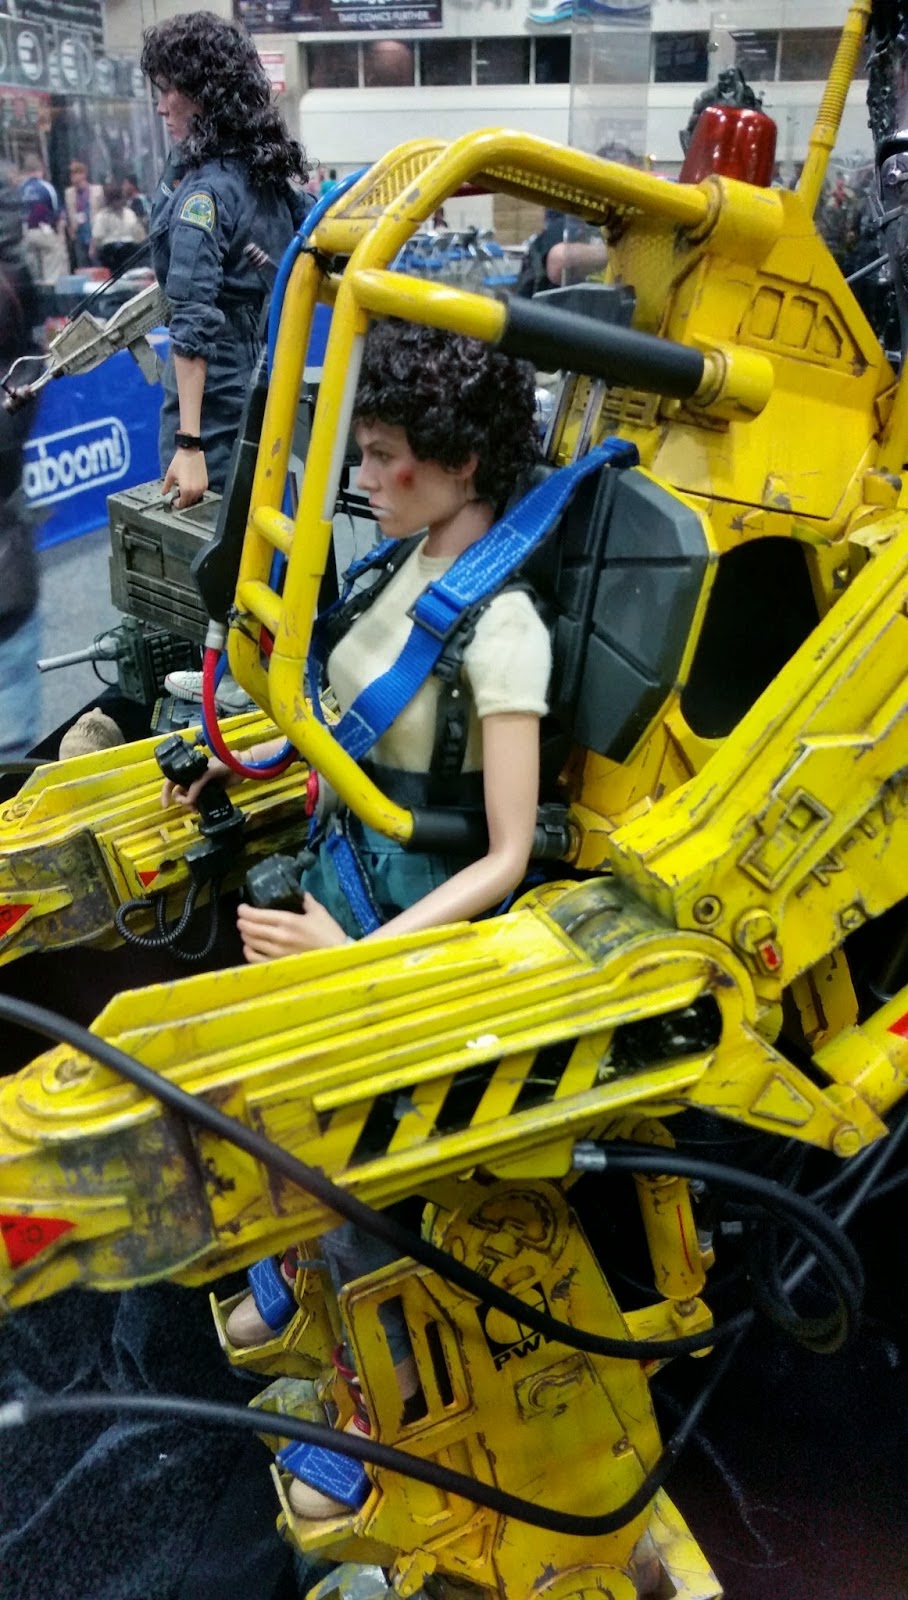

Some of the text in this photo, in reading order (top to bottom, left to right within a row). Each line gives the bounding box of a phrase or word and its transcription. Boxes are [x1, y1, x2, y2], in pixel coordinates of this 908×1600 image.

[359, 11, 391, 22] COMICS
[22, 424, 123, 498] aboom!
[493, 1335, 552, 1371] PW
